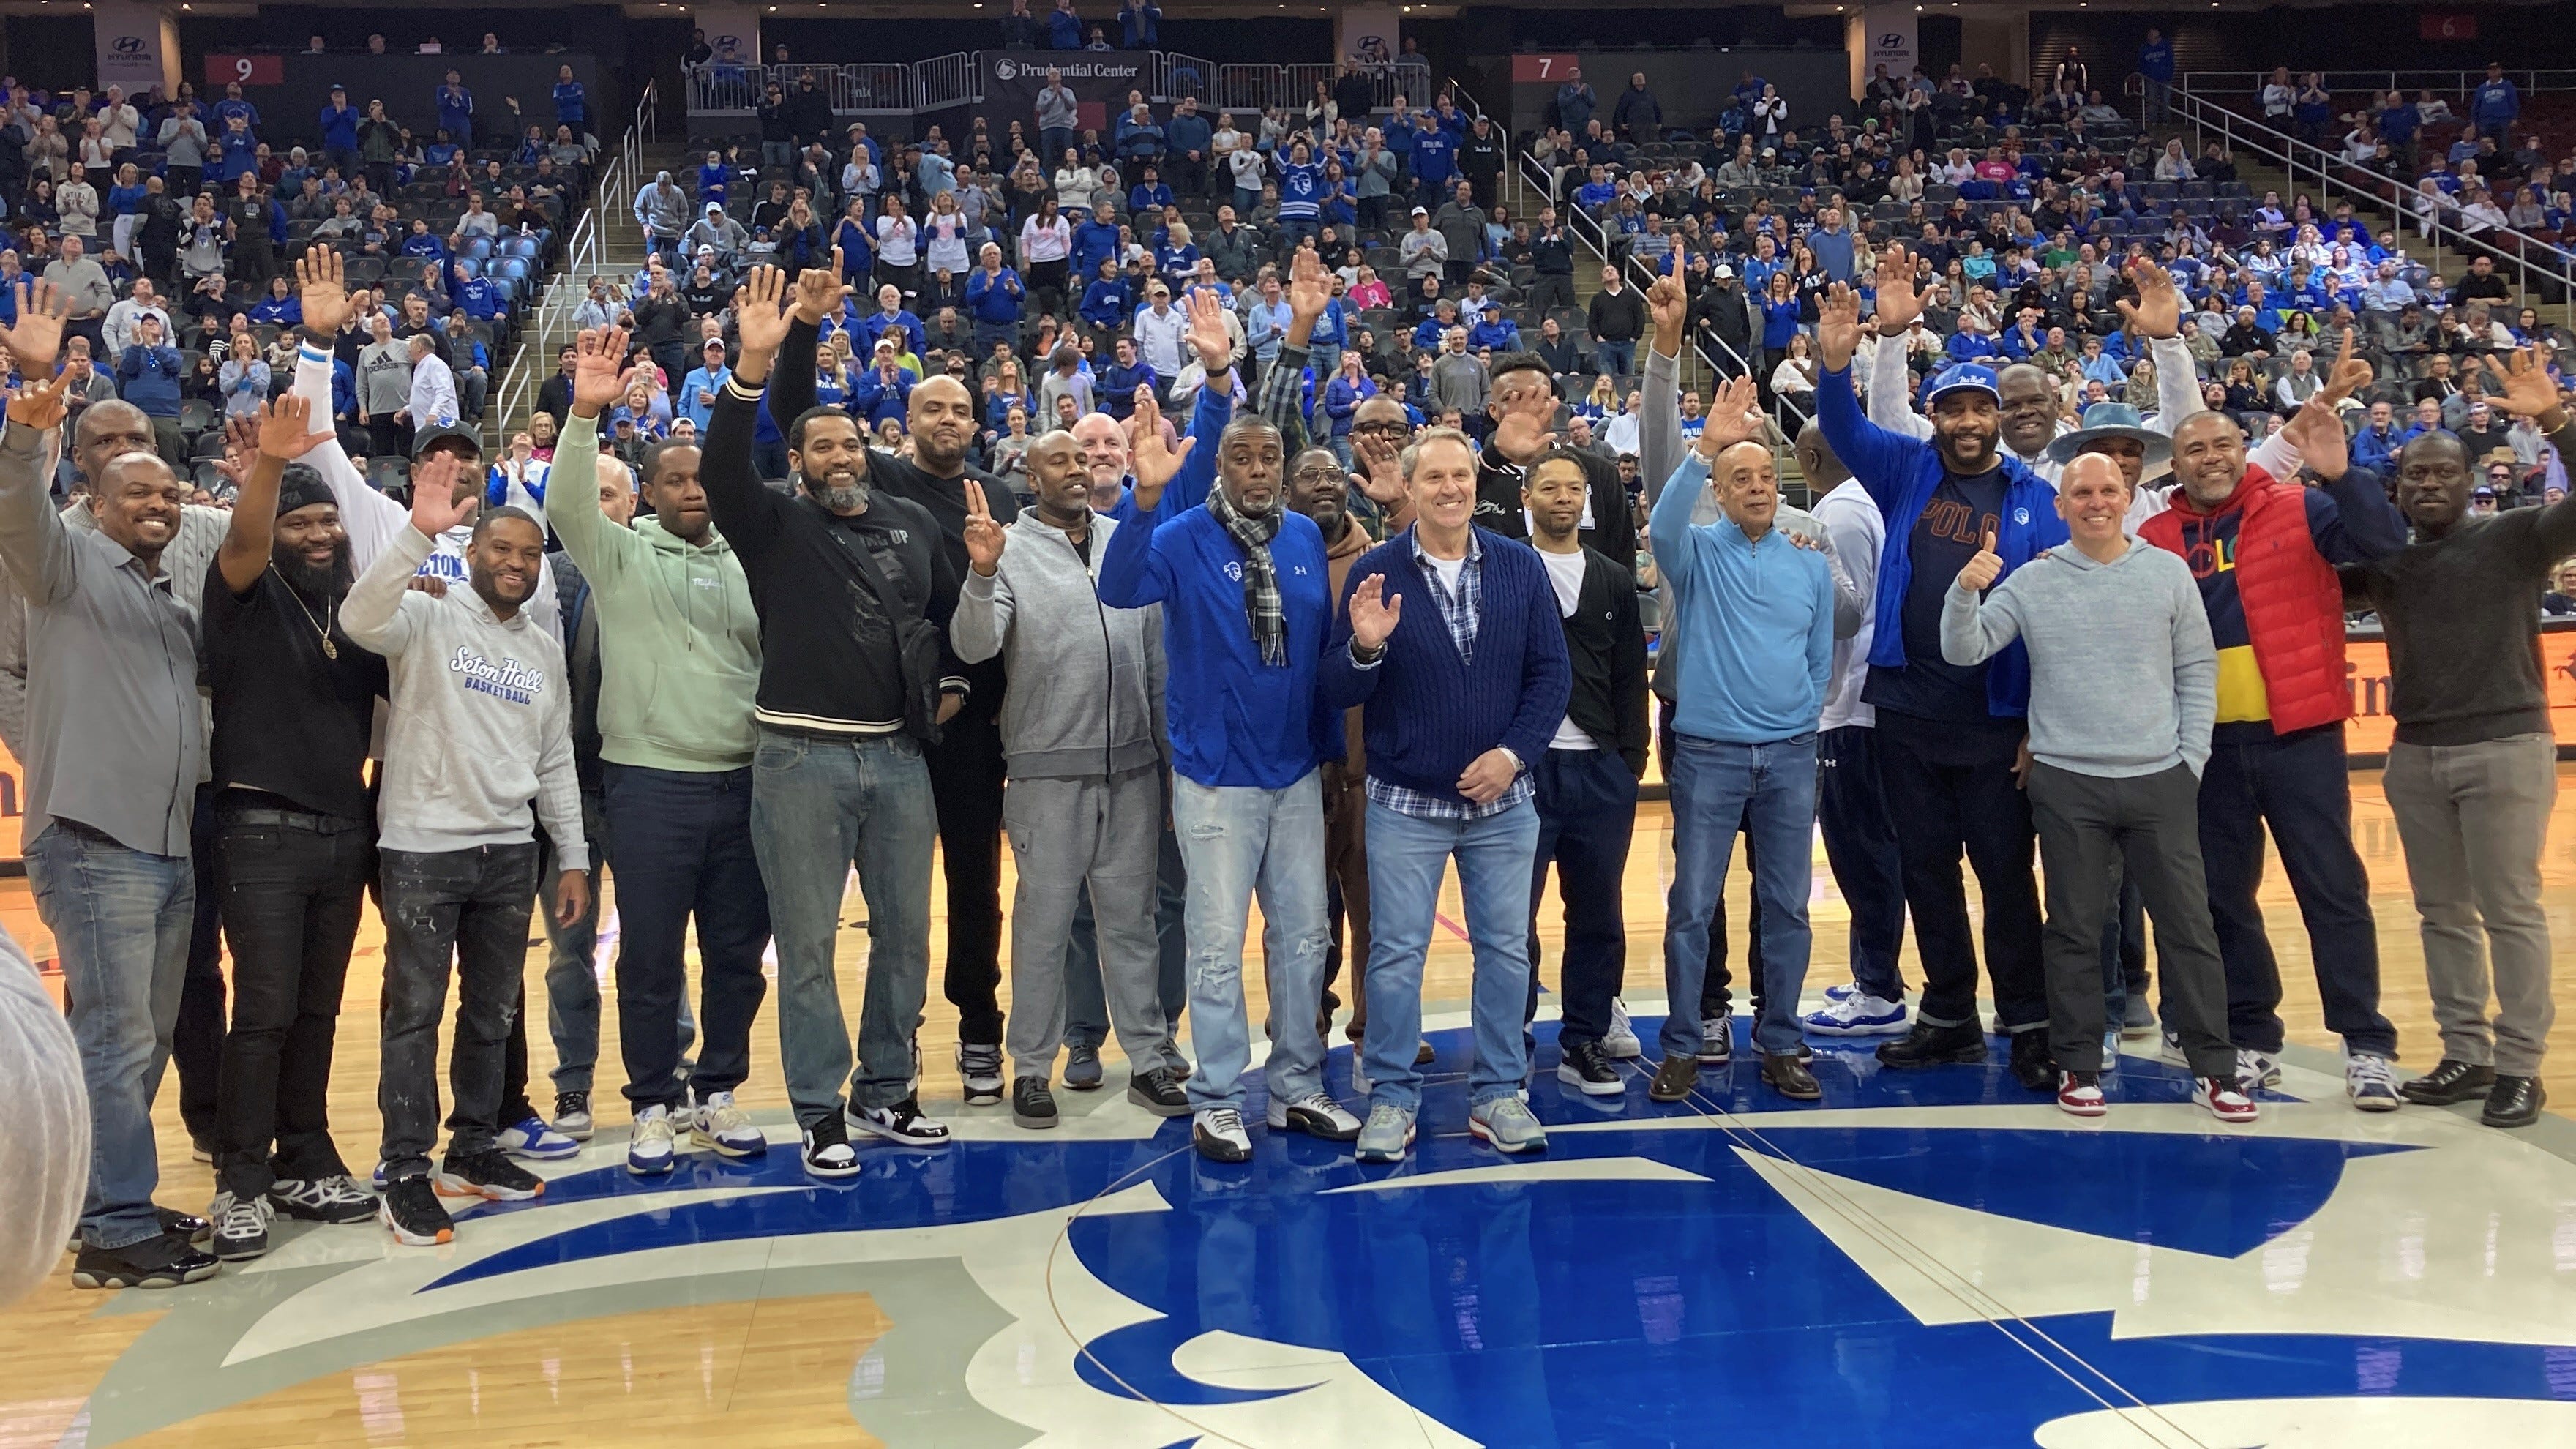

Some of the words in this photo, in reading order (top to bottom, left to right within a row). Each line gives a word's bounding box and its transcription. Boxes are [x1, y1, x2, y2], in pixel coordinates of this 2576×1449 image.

[2442, 17, 2455, 37] 6
[236, 58, 253, 81] 9
[1094, 62, 1138, 77] Center
[1538, 58, 1552, 79] 7
[368, 362, 399, 374] adidas
[889, 529, 909, 544] UP
[449, 645, 499, 683] Seton
[498, 657, 544, 694] Hall
[464, 676, 531, 705] BASKETBALL
